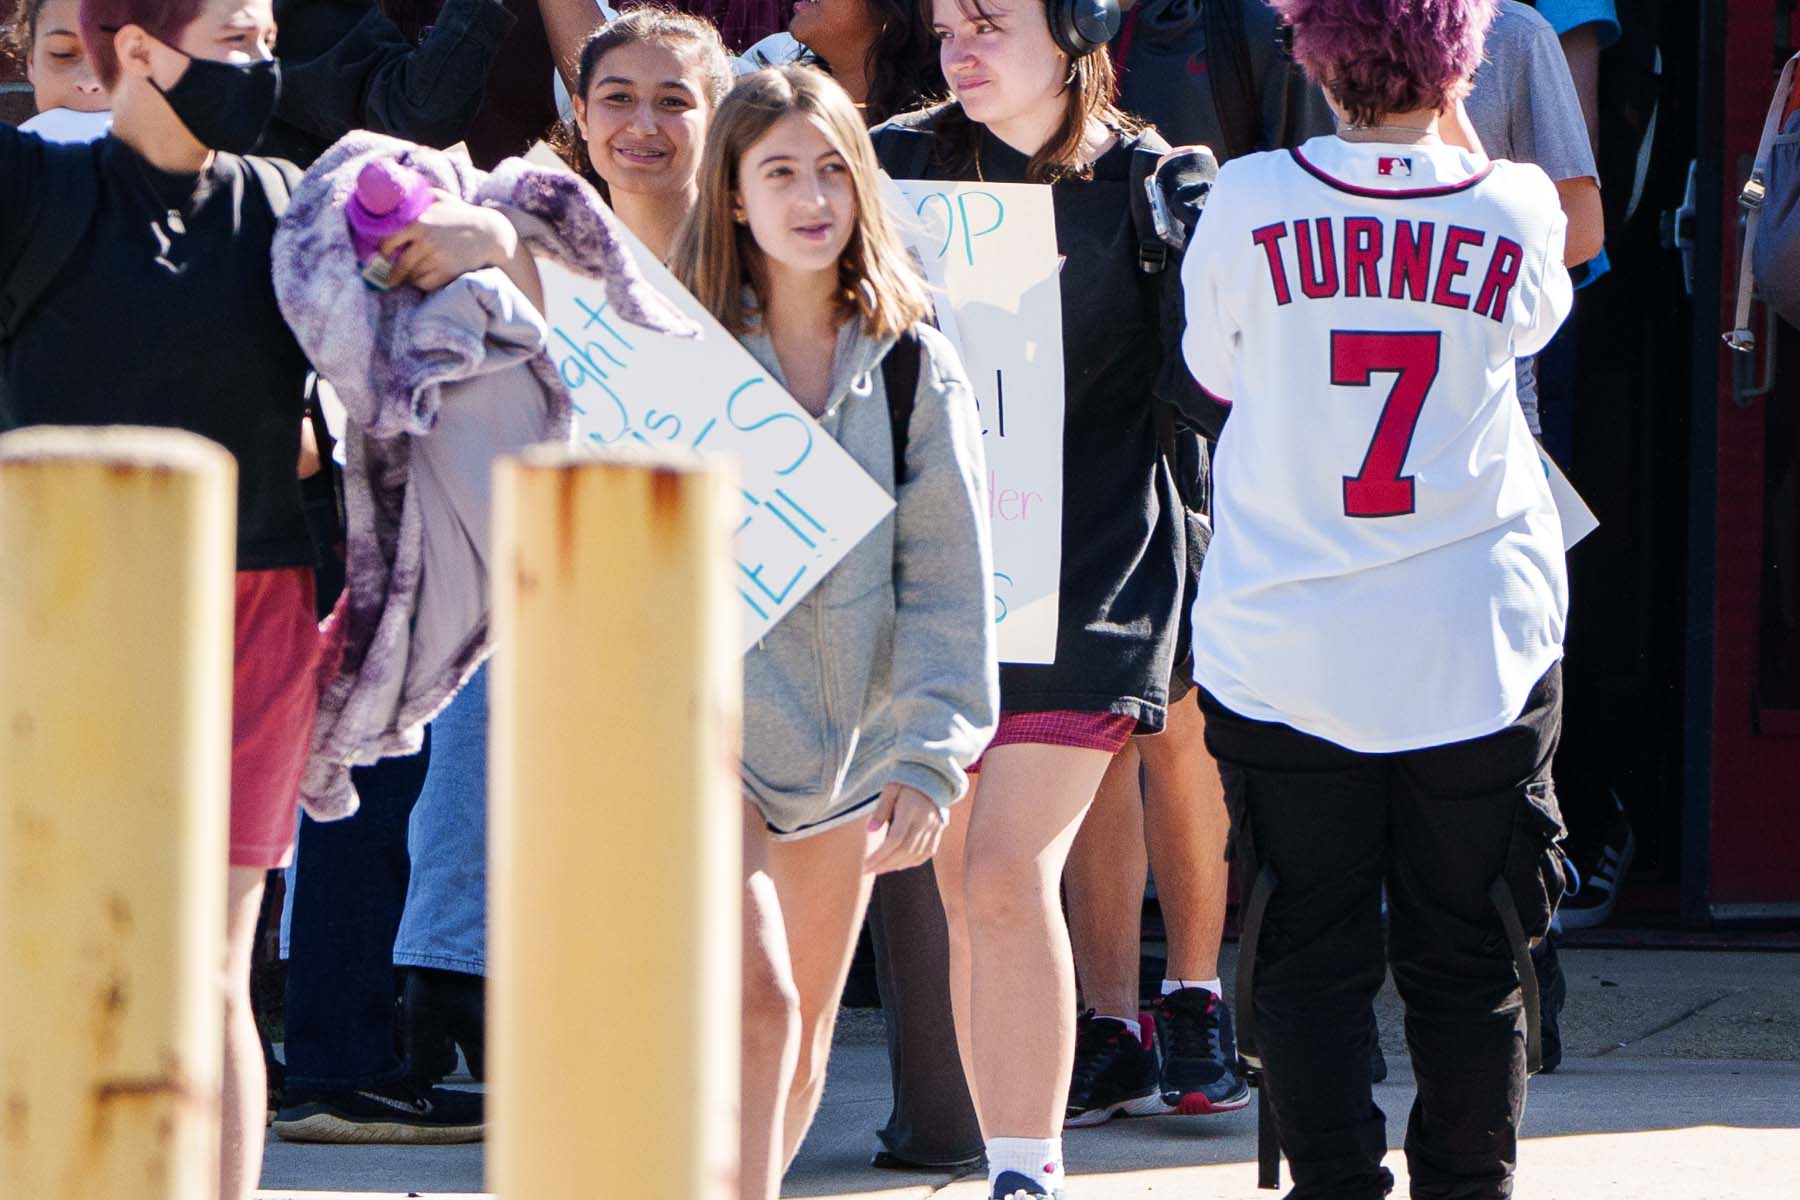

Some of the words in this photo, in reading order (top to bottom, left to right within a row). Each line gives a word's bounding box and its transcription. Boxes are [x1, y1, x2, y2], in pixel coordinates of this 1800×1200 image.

[903, 191, 1004, 266] OP
[1252, 216, 1524, 324] TURNER
[1330, 330, 1442, 519] 7
